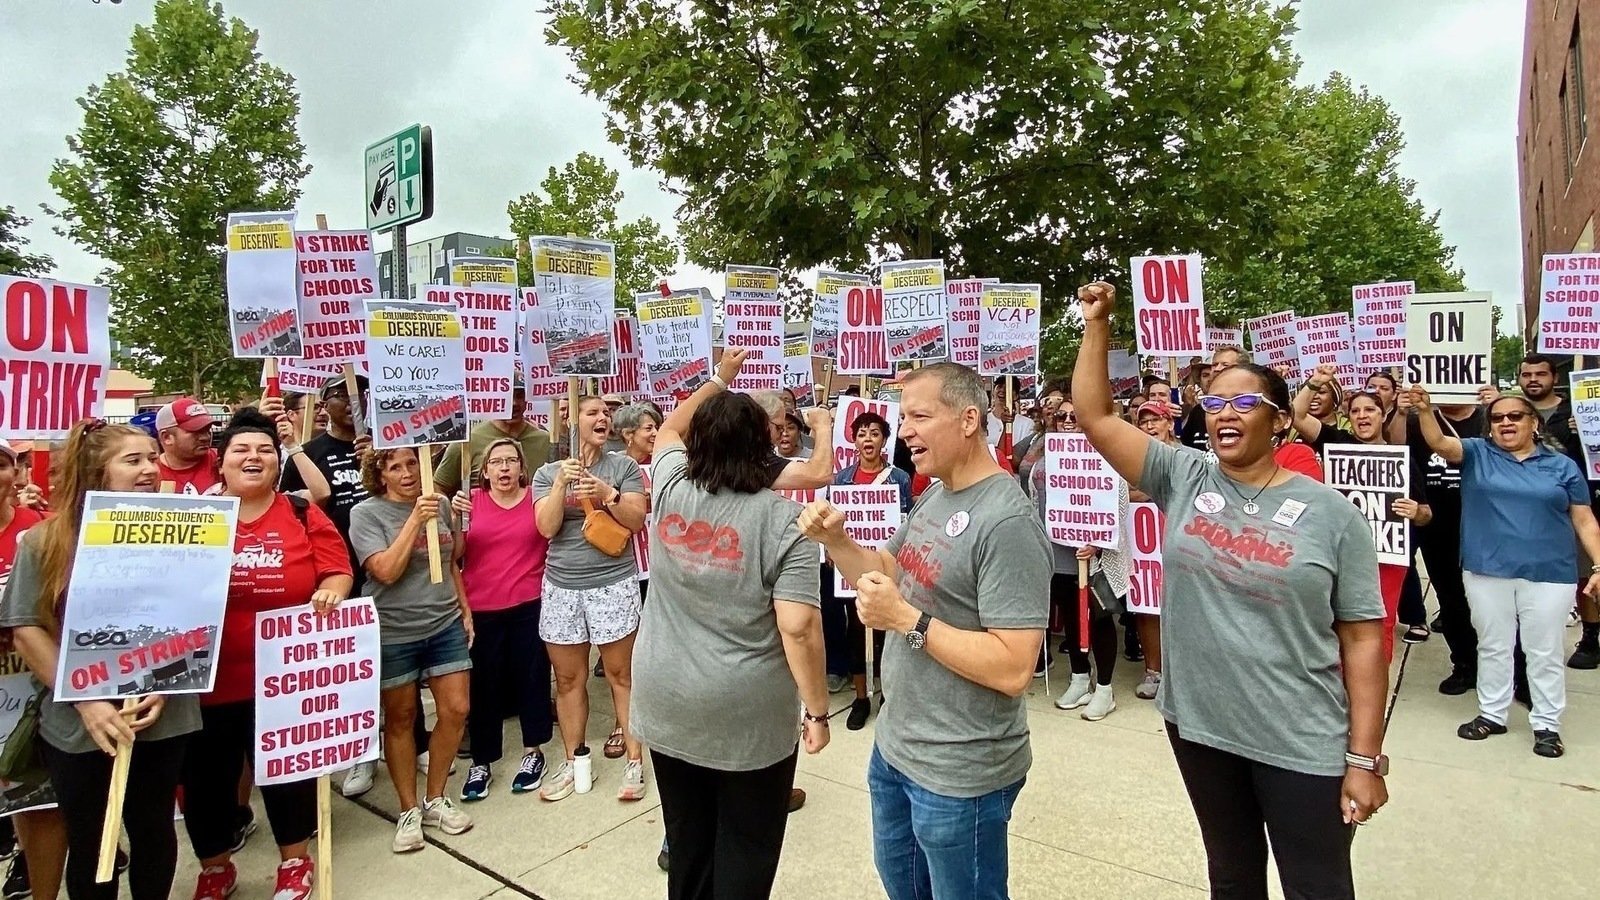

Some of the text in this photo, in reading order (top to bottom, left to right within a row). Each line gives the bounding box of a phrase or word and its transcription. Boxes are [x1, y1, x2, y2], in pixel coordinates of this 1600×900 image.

[368, 146, 395, 166] PAY HERE
[402, 137, 415, 174] P
[240, 233, 282, 249] DESERVE:
[309, 235, 369, 252] STRIKE
[300, 259, 356, 274] FOR THE
[549, 258, 598, 276] DESERVE:
[1546, 257, 1600, 271] ON STRI
[464, 272, 506, 282] DESERVE:
[894, 275, 932, 288] DESERVE:
[1143, 260, 1189, 304] ON
[1558, 275, 1599, 285] FOR TH
[304, 278, 374, 297] CHOOLS
[949, 282, 982, 294] ON STR
[1355, 285, 1412, 300] ON STRIKE
[427, 290, 512, 311] ON STRIKE
[960, 298, 974, 306] FOR
[993, 298, 1029, 307] DESERVE:
[1546, 290, 1599, 302] SCHOO
[320, 301, 350, 315] OUR
[650, 305, 691, 320] DESERVE:
[727, 304, 781, 316] ON STRIKE
[847, 288, 882, 327] ON
[885, 293, 944, 320] RESPECT
[1366, 300, 1402, 311] FOR THE
[1568, 307, 1592, 317] OUR
[6, 281, 88, 354] ON
[383, 312, 448, 321] COLUMBUS STUDENTS
[472, 316, 496, 330] THE
[952, 310, 980, 321] SCHO
[988, 308, 1035, 323] VCAP
[1250, 314, 1293, 331] ON STRIKE
[240, 310, 295, 350] ON STRIKE
[303, 319, 366, 339] TUDENT
[388, 321, 446, 337] DESERVE:
[642, 318, 699, 335] To be treated
[737, 321, 771, 330] FOR THE
[969, 324, 979, 333] OU
[1139, 308, 1202, 351] STRIKE
[1296, 316, 1347, 331] ON STRIKE
[1430, 312, 1464, 342] ON
[1542, 322, 1599, 333] STUDEN
[614, 320, 632, 353] N
[672, 332, 690, 344] they
[1259, 327, 1286, 340] FOR THE
[1308, 330, 1340, 341] FOR THE
[1376, 327, 1395, 336] OUR
[464, 336, 509, 353] OOLS
[728, 335, 780, 346] SCHOOLS
[814, 344, 825, 352] ON
[891, 325, 944, 357] ON STRIKE
[952, 337, 978, 348] STUD
[1255, 336, 1295, 353] SCHOOLS
[1301, 341, 1349, 355] SCHOOLS
[1359, 339, 1406, 350] STUDENT
[1545, 337, 1600, 349] DESERV
[303, 340, 365, 360] DESERV
[385, 343, 446, 358] WE CARE!
[956, 351, 978, 361] DESE
[1269, 350, 1284, 360] OUR
[465, 358, 483, 371] UR
[984, 346, 1033, 370] ON STRIKE
[1319, 355, 1336, 364] OUR
[1362, 352, 1406, 364] DESERV
[383, 366, 439, 380] DO YOU?
[654, 357, 708, 392] ON STRIKE
[741, 364, 781, 375] UDENTS
[1408, 354, 1486, 384] STRIKE
[730, 379, 779, 389] DESERVE!
[382, 396, 464, 441] ON STRIKE
[1048, 438, 1064, 452] ON
[1059, 458, 1102, 470] FOR THE
[1329, 458, 1405, 488] TEACHERS
[1050, 475, 1113, 490] SCHOOLS
[832, 490, 896, 504] ON STRIKE
[1070, 494, 1091, 506] OUR
[1348, 490, 1386, 521] ON
[110, 511, 214, 523] COLUMBUS STUDENTS
[845, 510, 885, 521] FOR THE
[1048, 509, 1115, 526] STUDENTS
[113, 524, 206, 544] DESERVE:
[846, 526, 896, 541] CHOOLS
[1051, 527, 1112, 542] DESERVE!
[1372, 520, 1405, 555] IKE
[1130, 559, 1162, 607] STR
[261, 604, 375, 640] ON STRIKE
[75, 631, 129, 646] cea
[283, 636, 356, 664] FOR THE
[71, 661, 109, 690] ON
[119, 626, 210, 674] STRIKE
[264, 659, 373, 698] SCHOOLS
[301, 692, 339, 716] OUR
[261, 710, 375, 752] STUDENTS
[267, 737, 370, 778] DESERVE!
